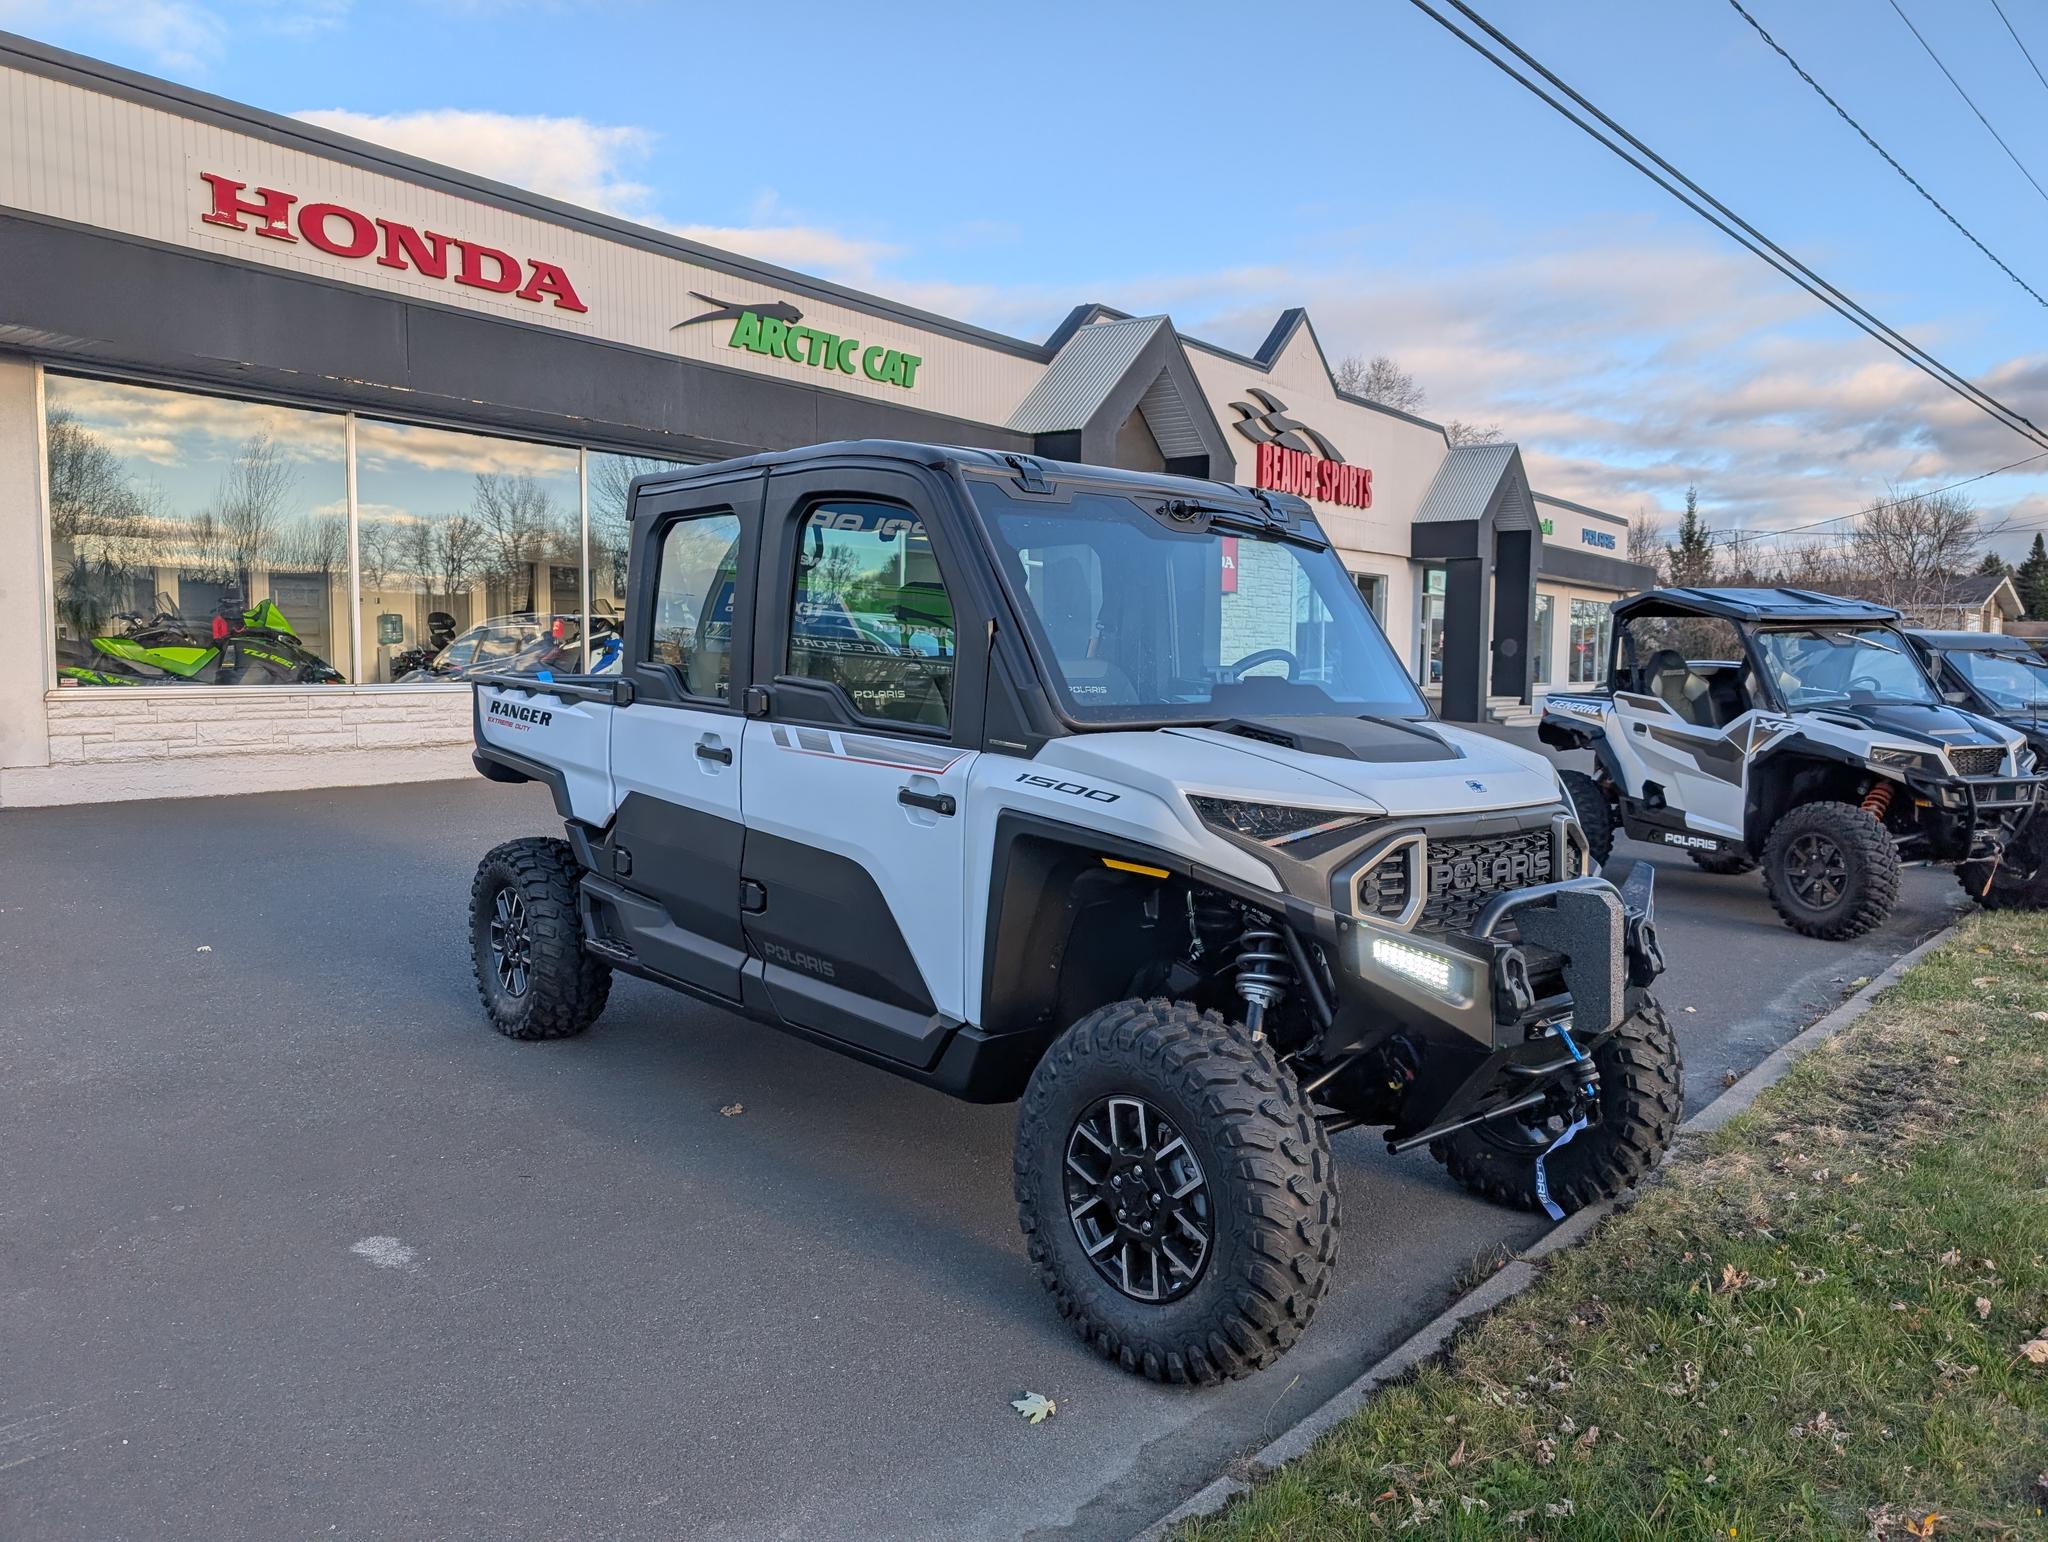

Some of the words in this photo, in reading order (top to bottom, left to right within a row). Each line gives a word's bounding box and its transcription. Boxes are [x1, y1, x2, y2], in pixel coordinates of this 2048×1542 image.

[201, 171, 588, 313] HONDA
[728, 311, 860, 375] ARCTIC
[862, 345, 922, 389] CAT
[1257, 442, 1319, 498] BEAUCE
[1317, 459, 1373, 509] SPORTS
[1581, 528, 1616, 550] POLARIS
[854, 689, 906, 699] POLARIS
[1550, 699, 1601, 716] GENERAL
[487, 716, 514, 729] EXTREME
[514, 723, 532, 733] DUTY
[489, 700, 553, 727] RANGER
[1755, 718, 1801, 732] XP
[1015, 773, 1121, 803] 1500
[1665, 833, 1717, 851] POLARIS
[1429, 850, 1550, 893] POLARIS
[764, 942, 836, 978] POLARIS
